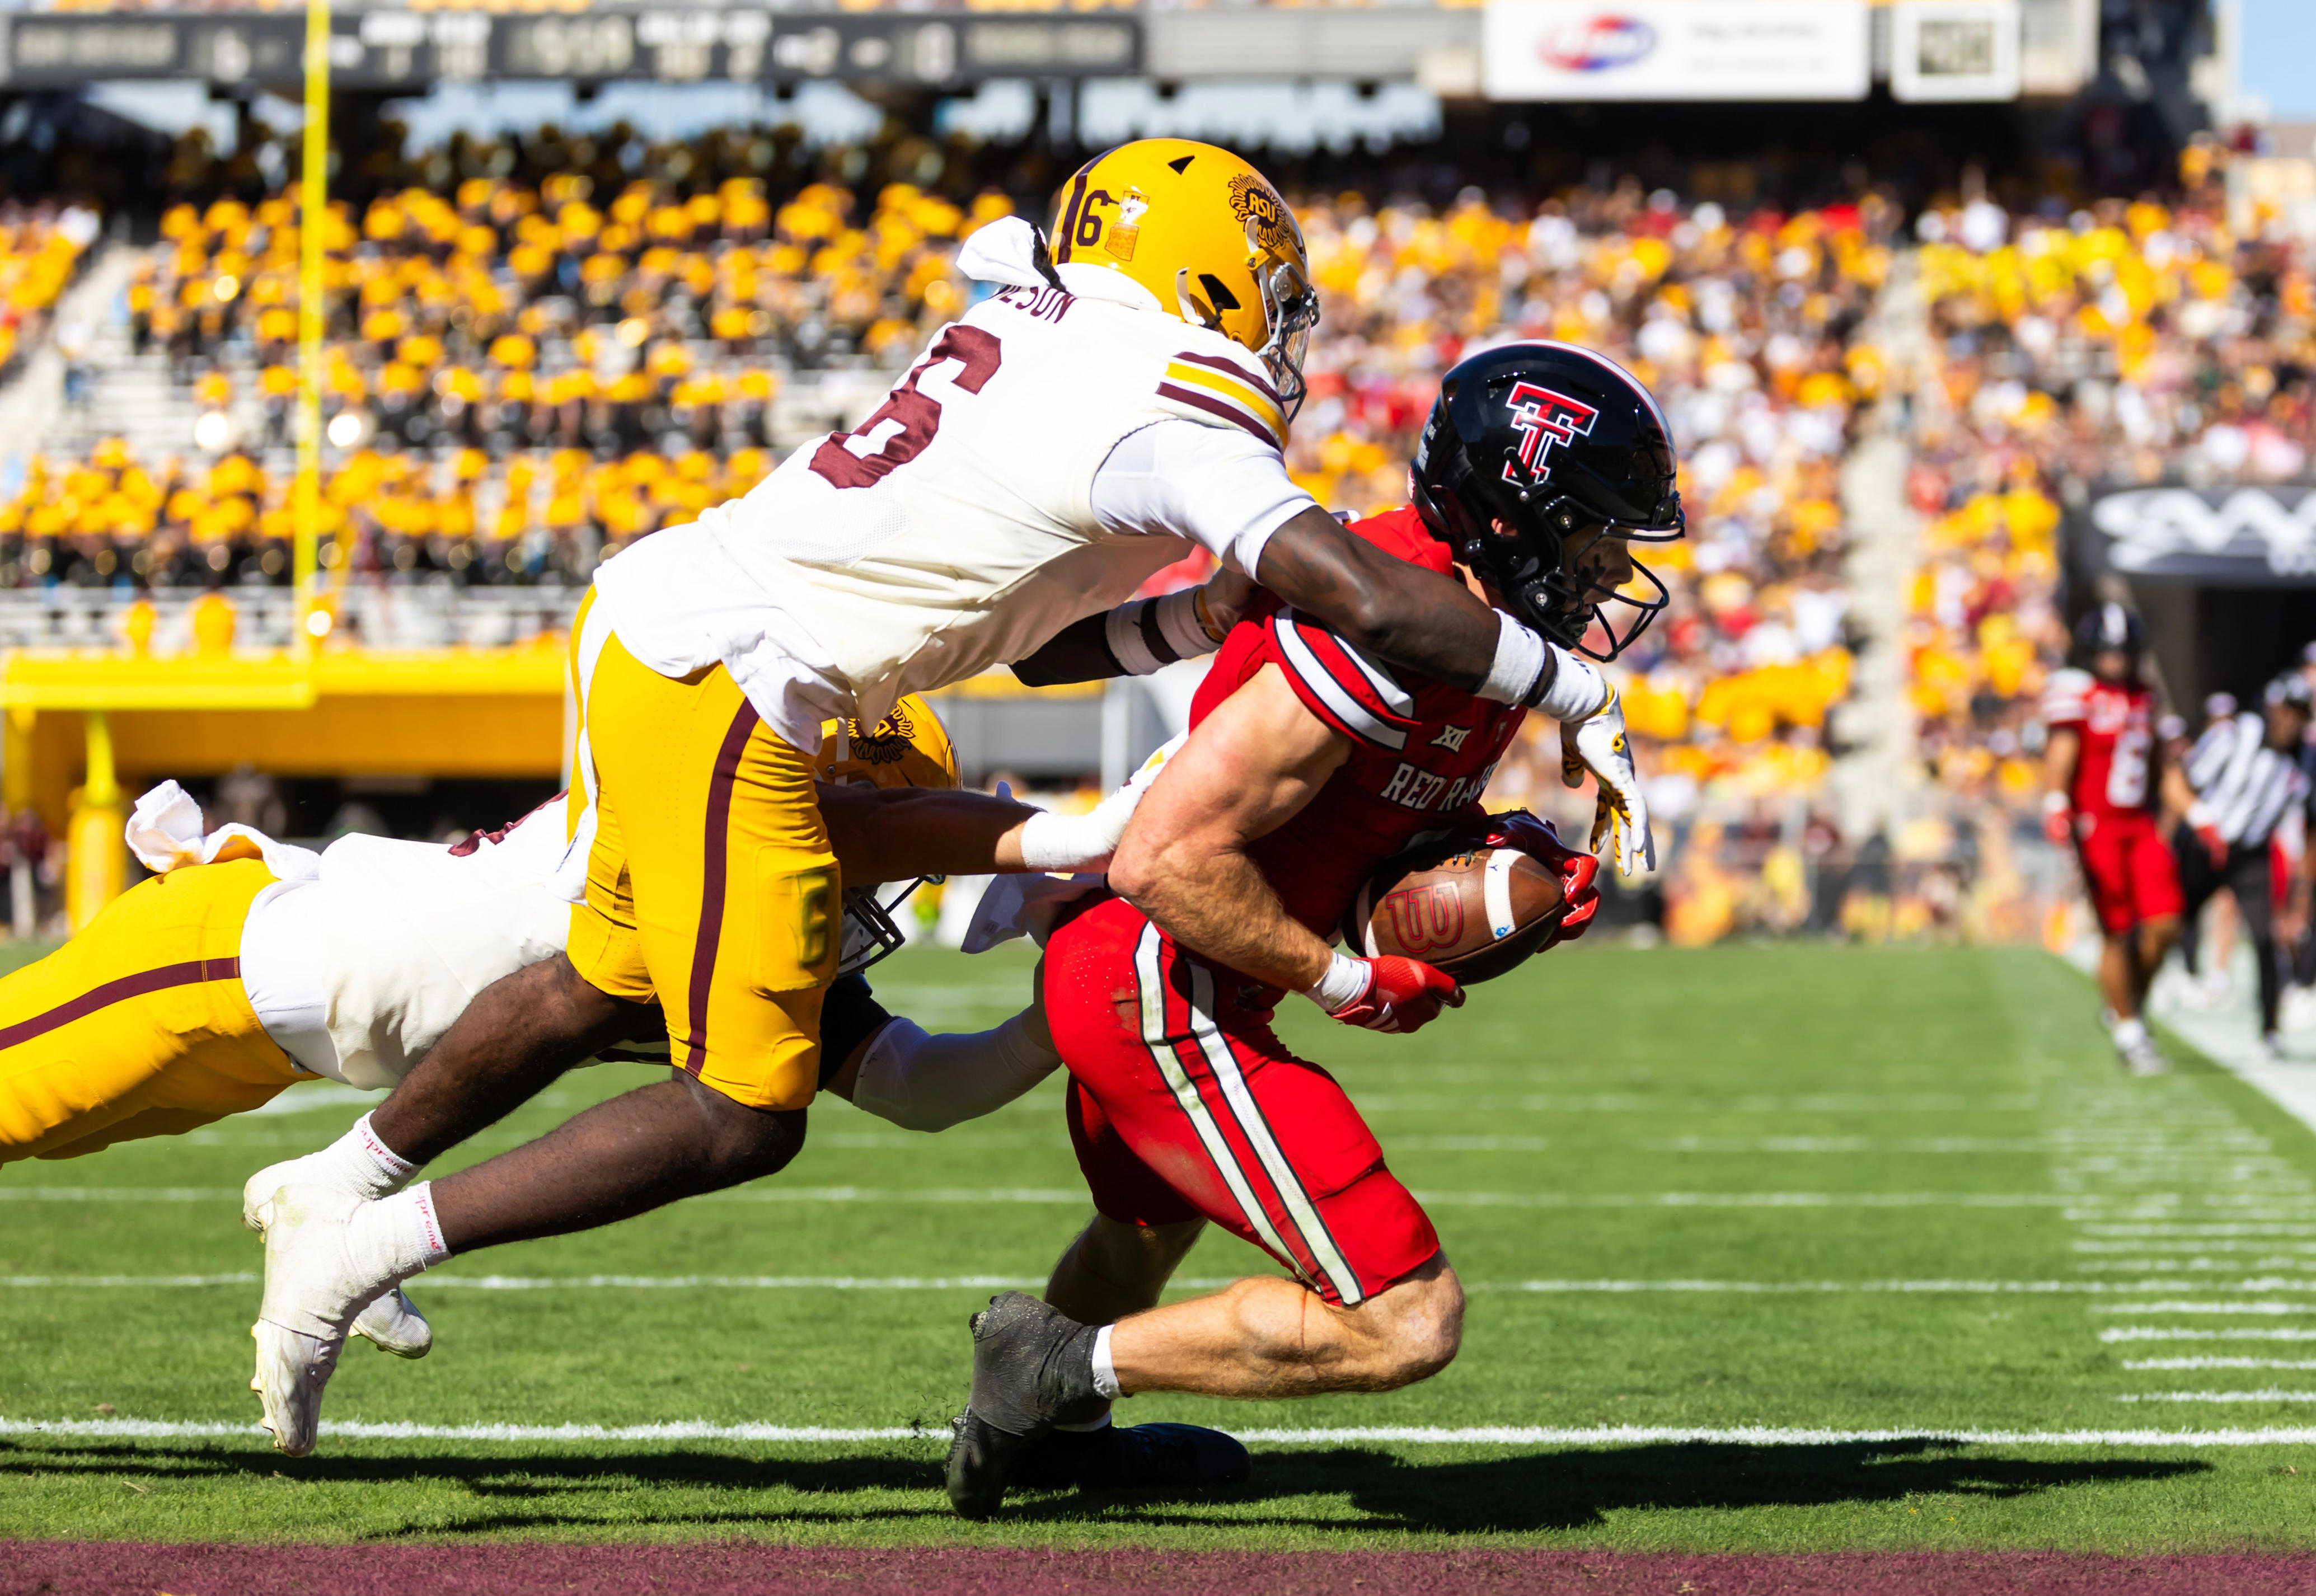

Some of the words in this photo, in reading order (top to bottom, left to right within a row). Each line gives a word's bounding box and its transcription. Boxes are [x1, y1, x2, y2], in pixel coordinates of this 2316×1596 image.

[1076, 190, 1110, 246] 6
[1249, 193, 1276, 223] ASU
[808, 325, 1001, 489] 6
[1380, 762, 1447, 809] RED
[1386, 880, 1464, 954] W
[361, 1121, 411, 1173] Supreme
